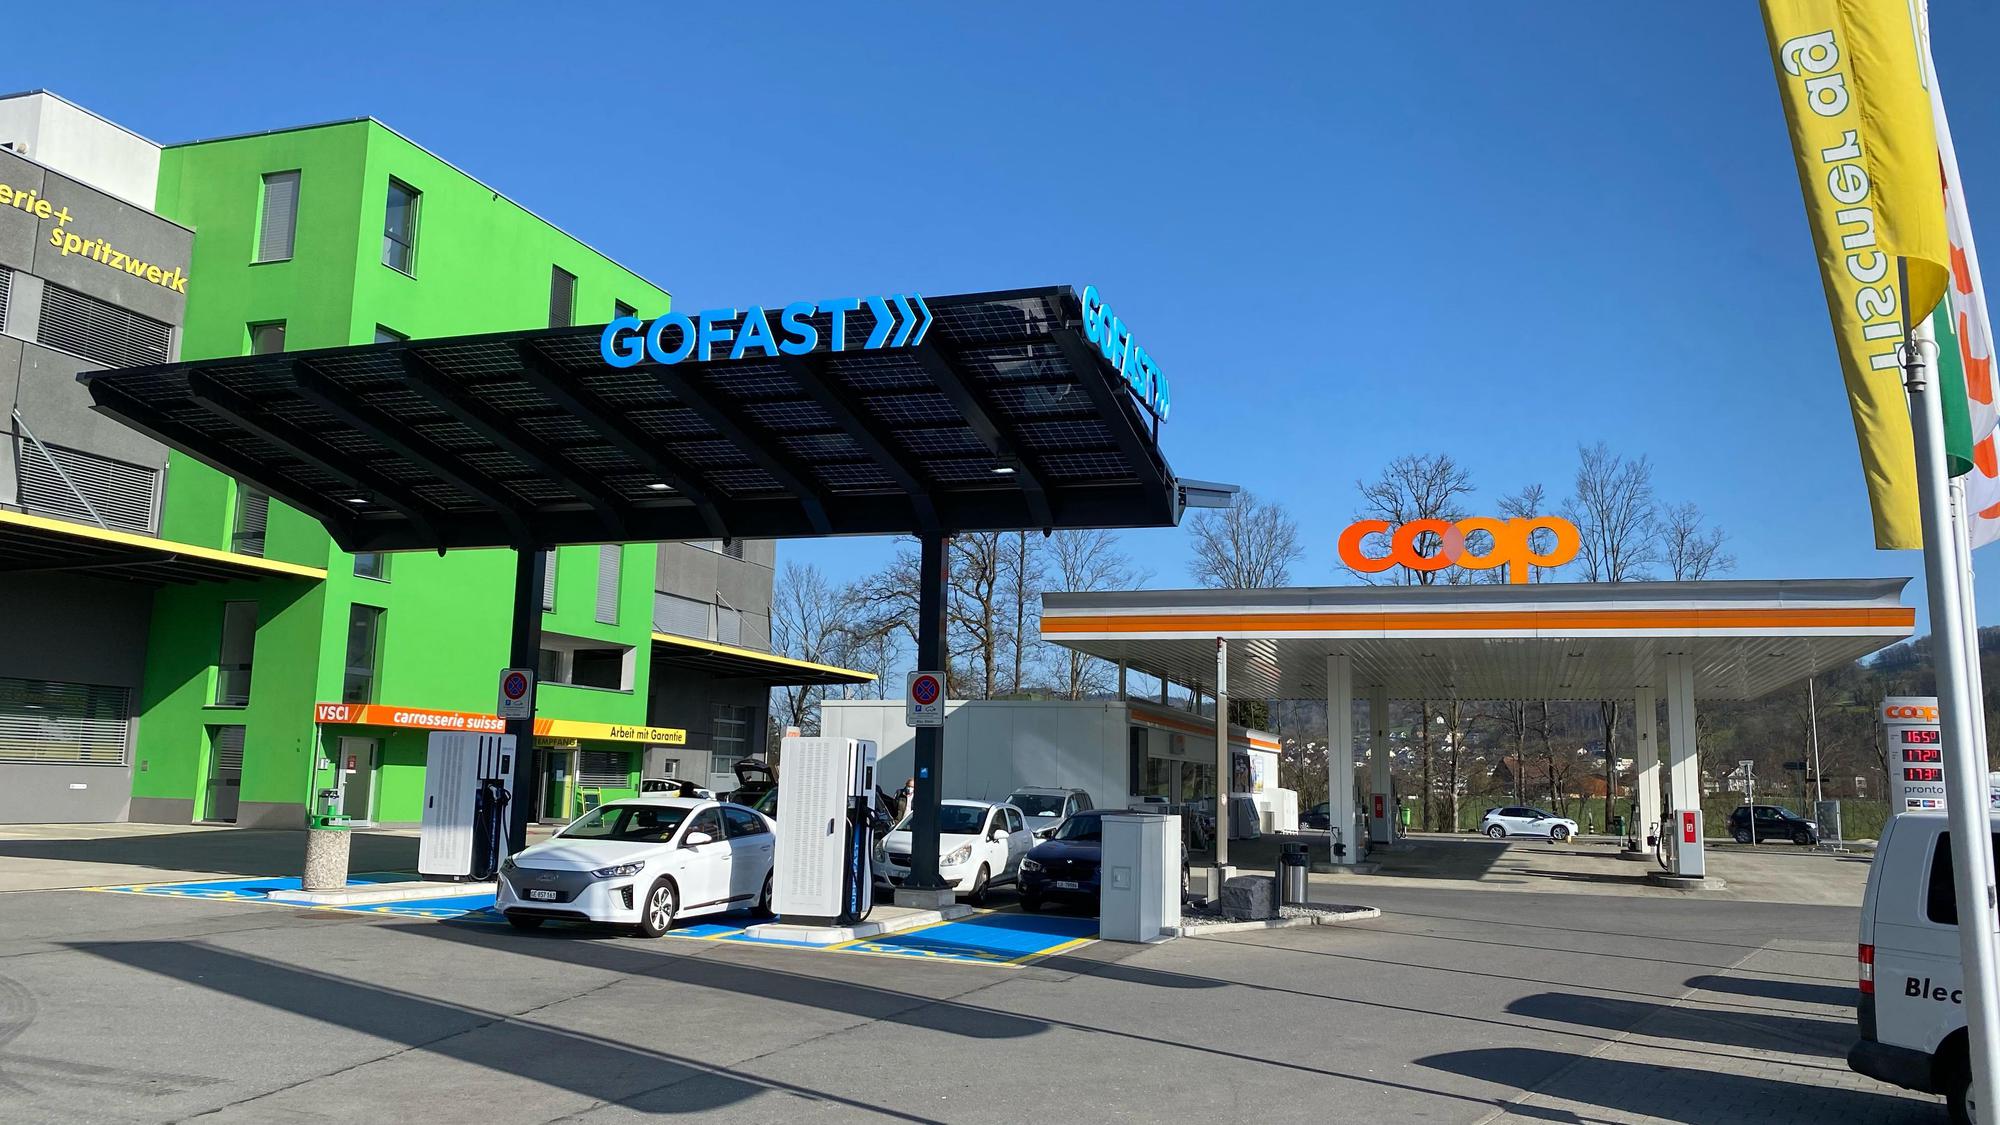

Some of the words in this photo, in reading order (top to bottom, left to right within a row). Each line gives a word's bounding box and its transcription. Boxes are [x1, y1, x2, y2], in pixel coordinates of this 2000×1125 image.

[50, 227, 188, 294] spritzwerk
[601, 297, 860, 368] GOFAST
[1082, 285, 1158, 406] GOFAST
[1337, 516, 1581, 584] coop
[318, 705, 349, 721] VSCI
[393, 711, 464, 728] carrosserie
[466, 715, 504, 730] suisse
[610, 726, 635, 739] Arbeit
[636, 728, 649, 740] mit
[650, 729, 683, 742] Garantie
[1904, 786, 1944, 794] pronto
